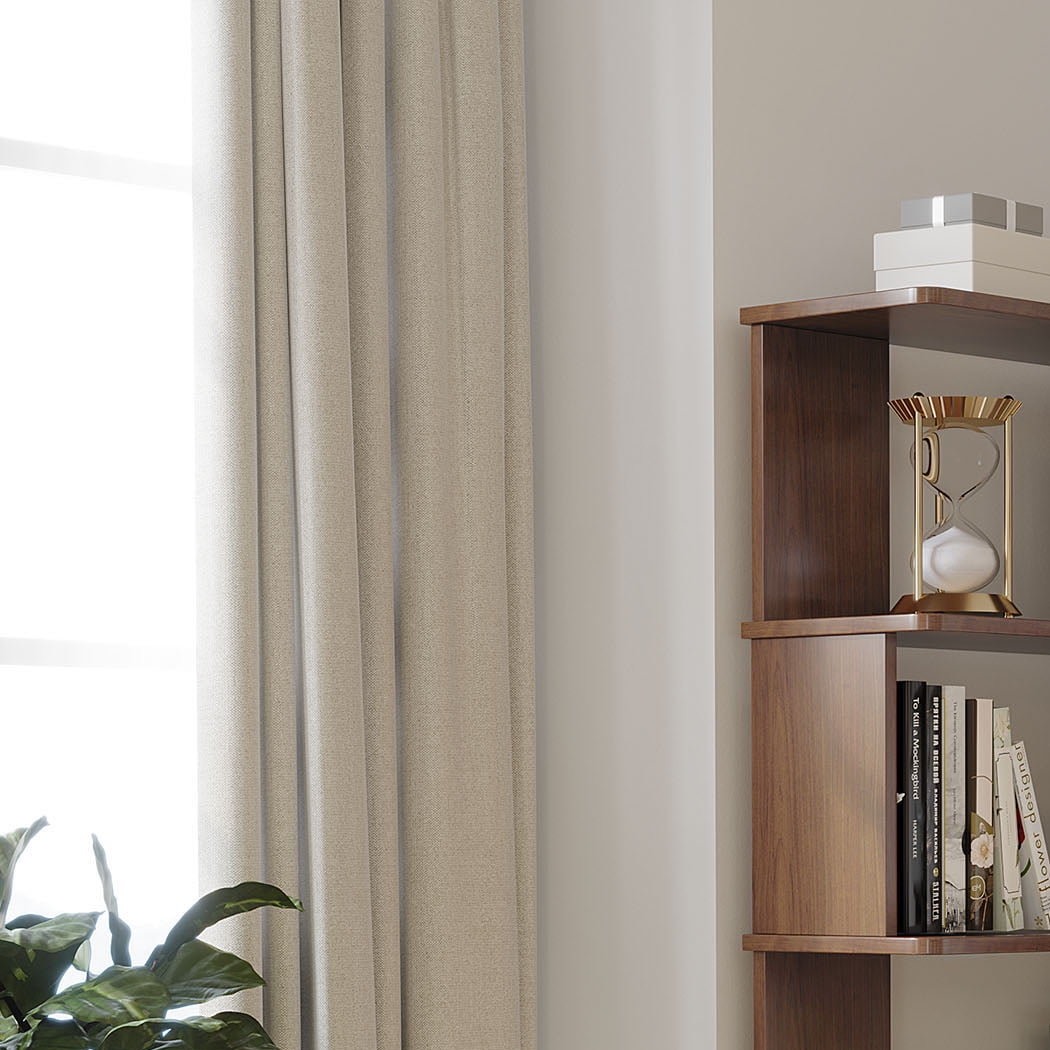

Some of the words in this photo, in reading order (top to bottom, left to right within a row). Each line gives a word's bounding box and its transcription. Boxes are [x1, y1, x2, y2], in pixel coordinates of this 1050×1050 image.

[912, 697, 920, 710] To
[912, 712, 920, 728] Kill
[910, 738, 920, 800] Mockingbird
[1014, 745, 1037, 824] designer
[1032, 832, 1050, 892] flower
